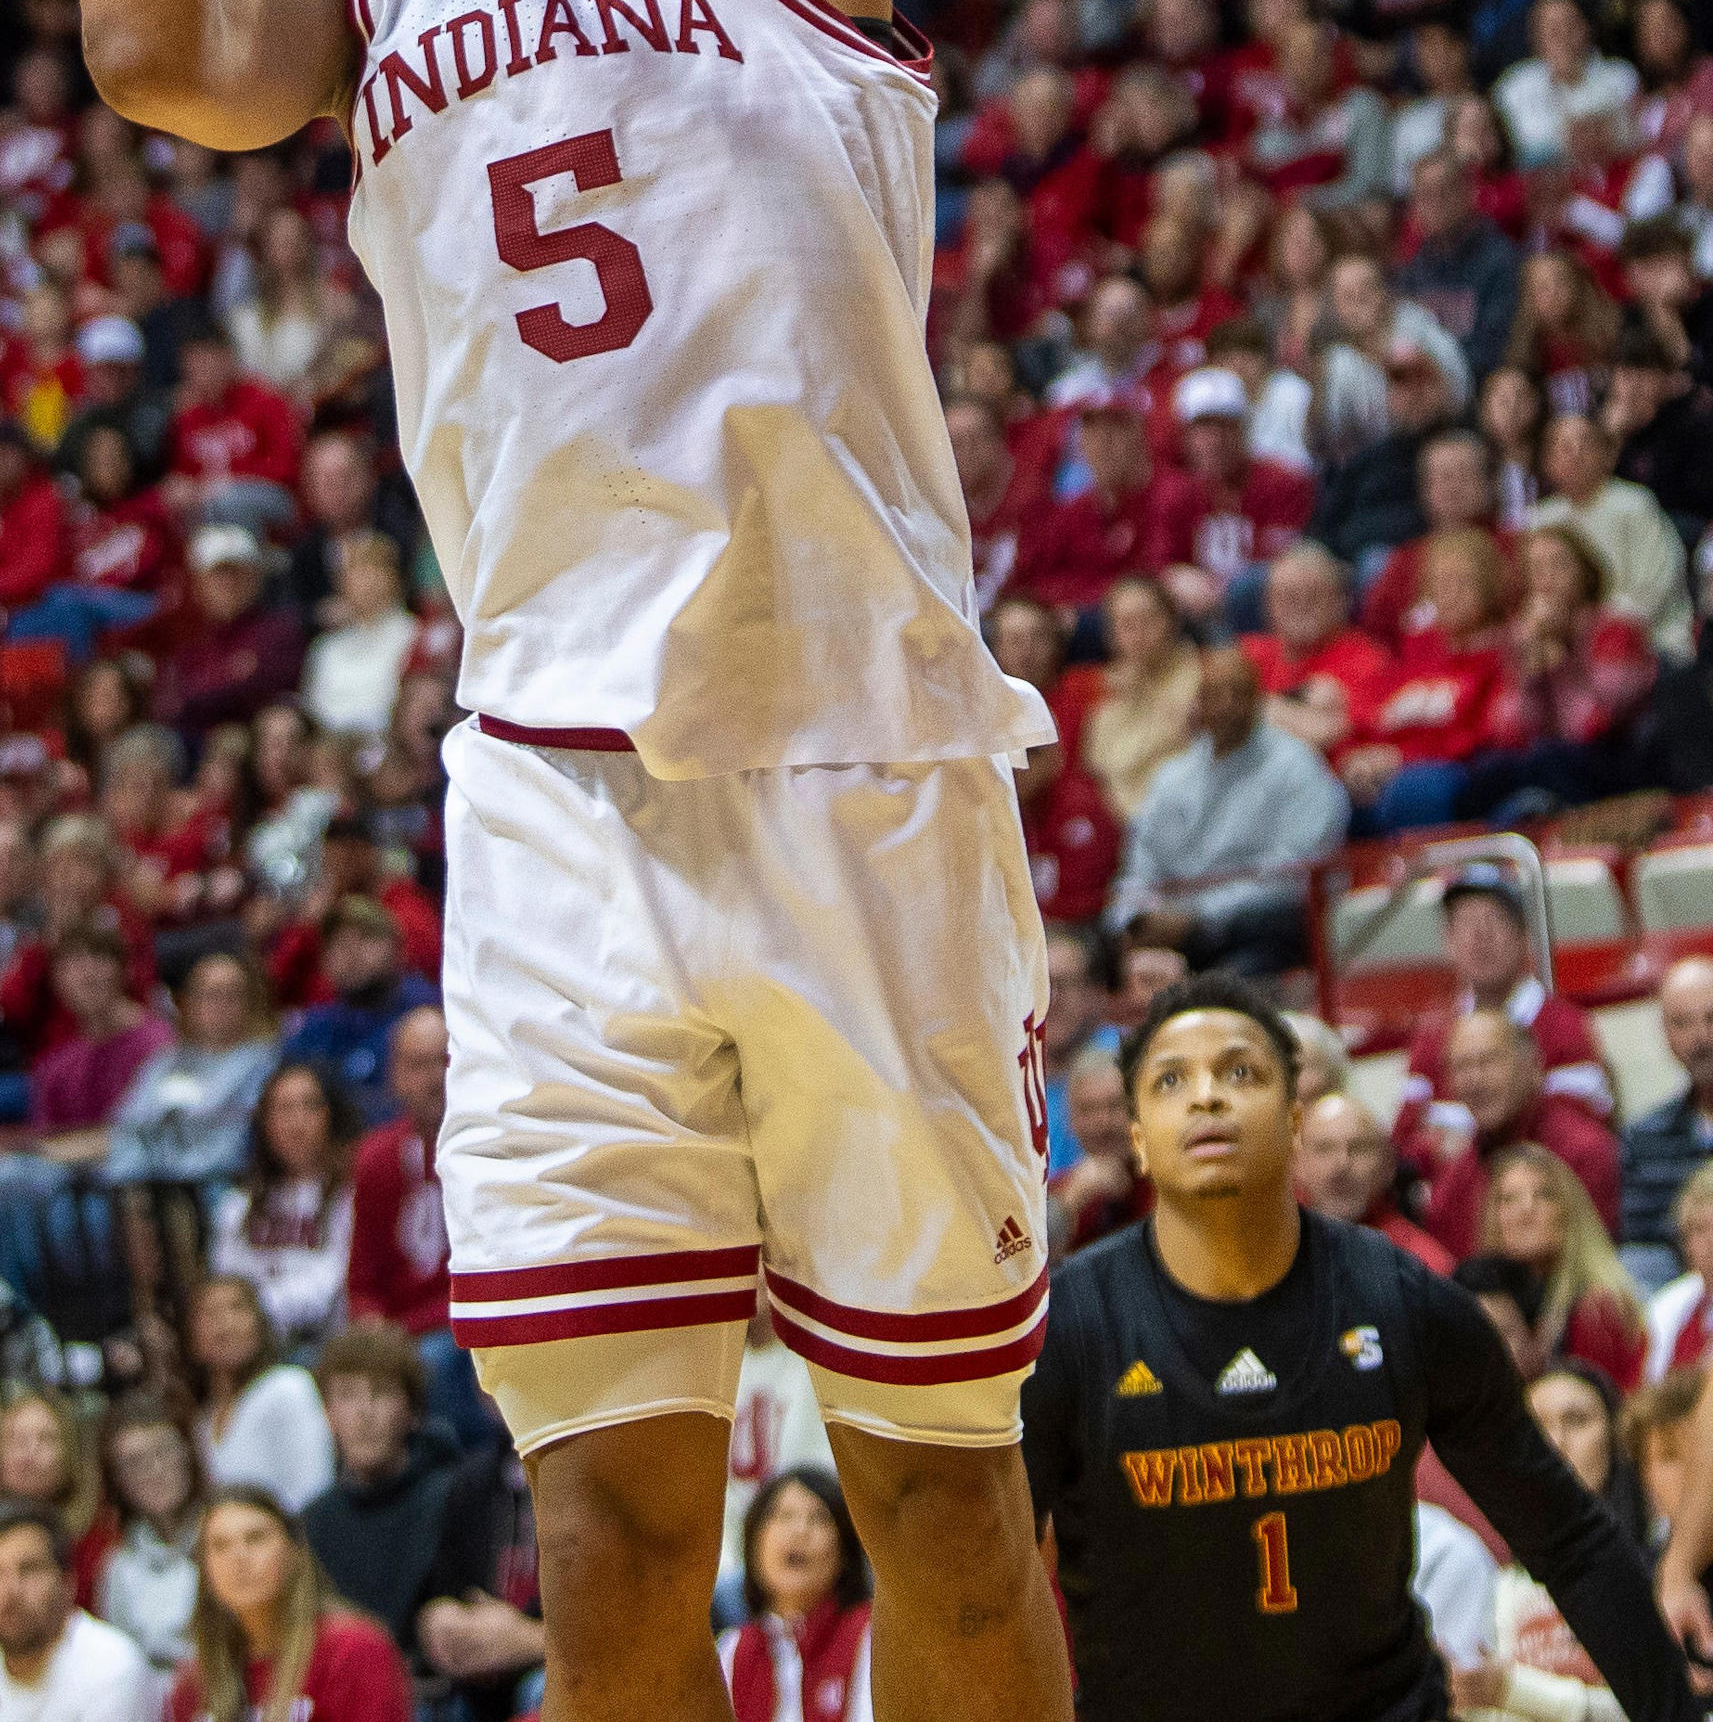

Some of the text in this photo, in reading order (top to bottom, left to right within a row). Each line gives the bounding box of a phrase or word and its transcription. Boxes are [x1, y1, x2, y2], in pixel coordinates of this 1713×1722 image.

[486, 127, 654, 364] 5
[1120, 1419, 1401, 1509] WINTHROP
[1250, 1510, 1298, 1615] 1
